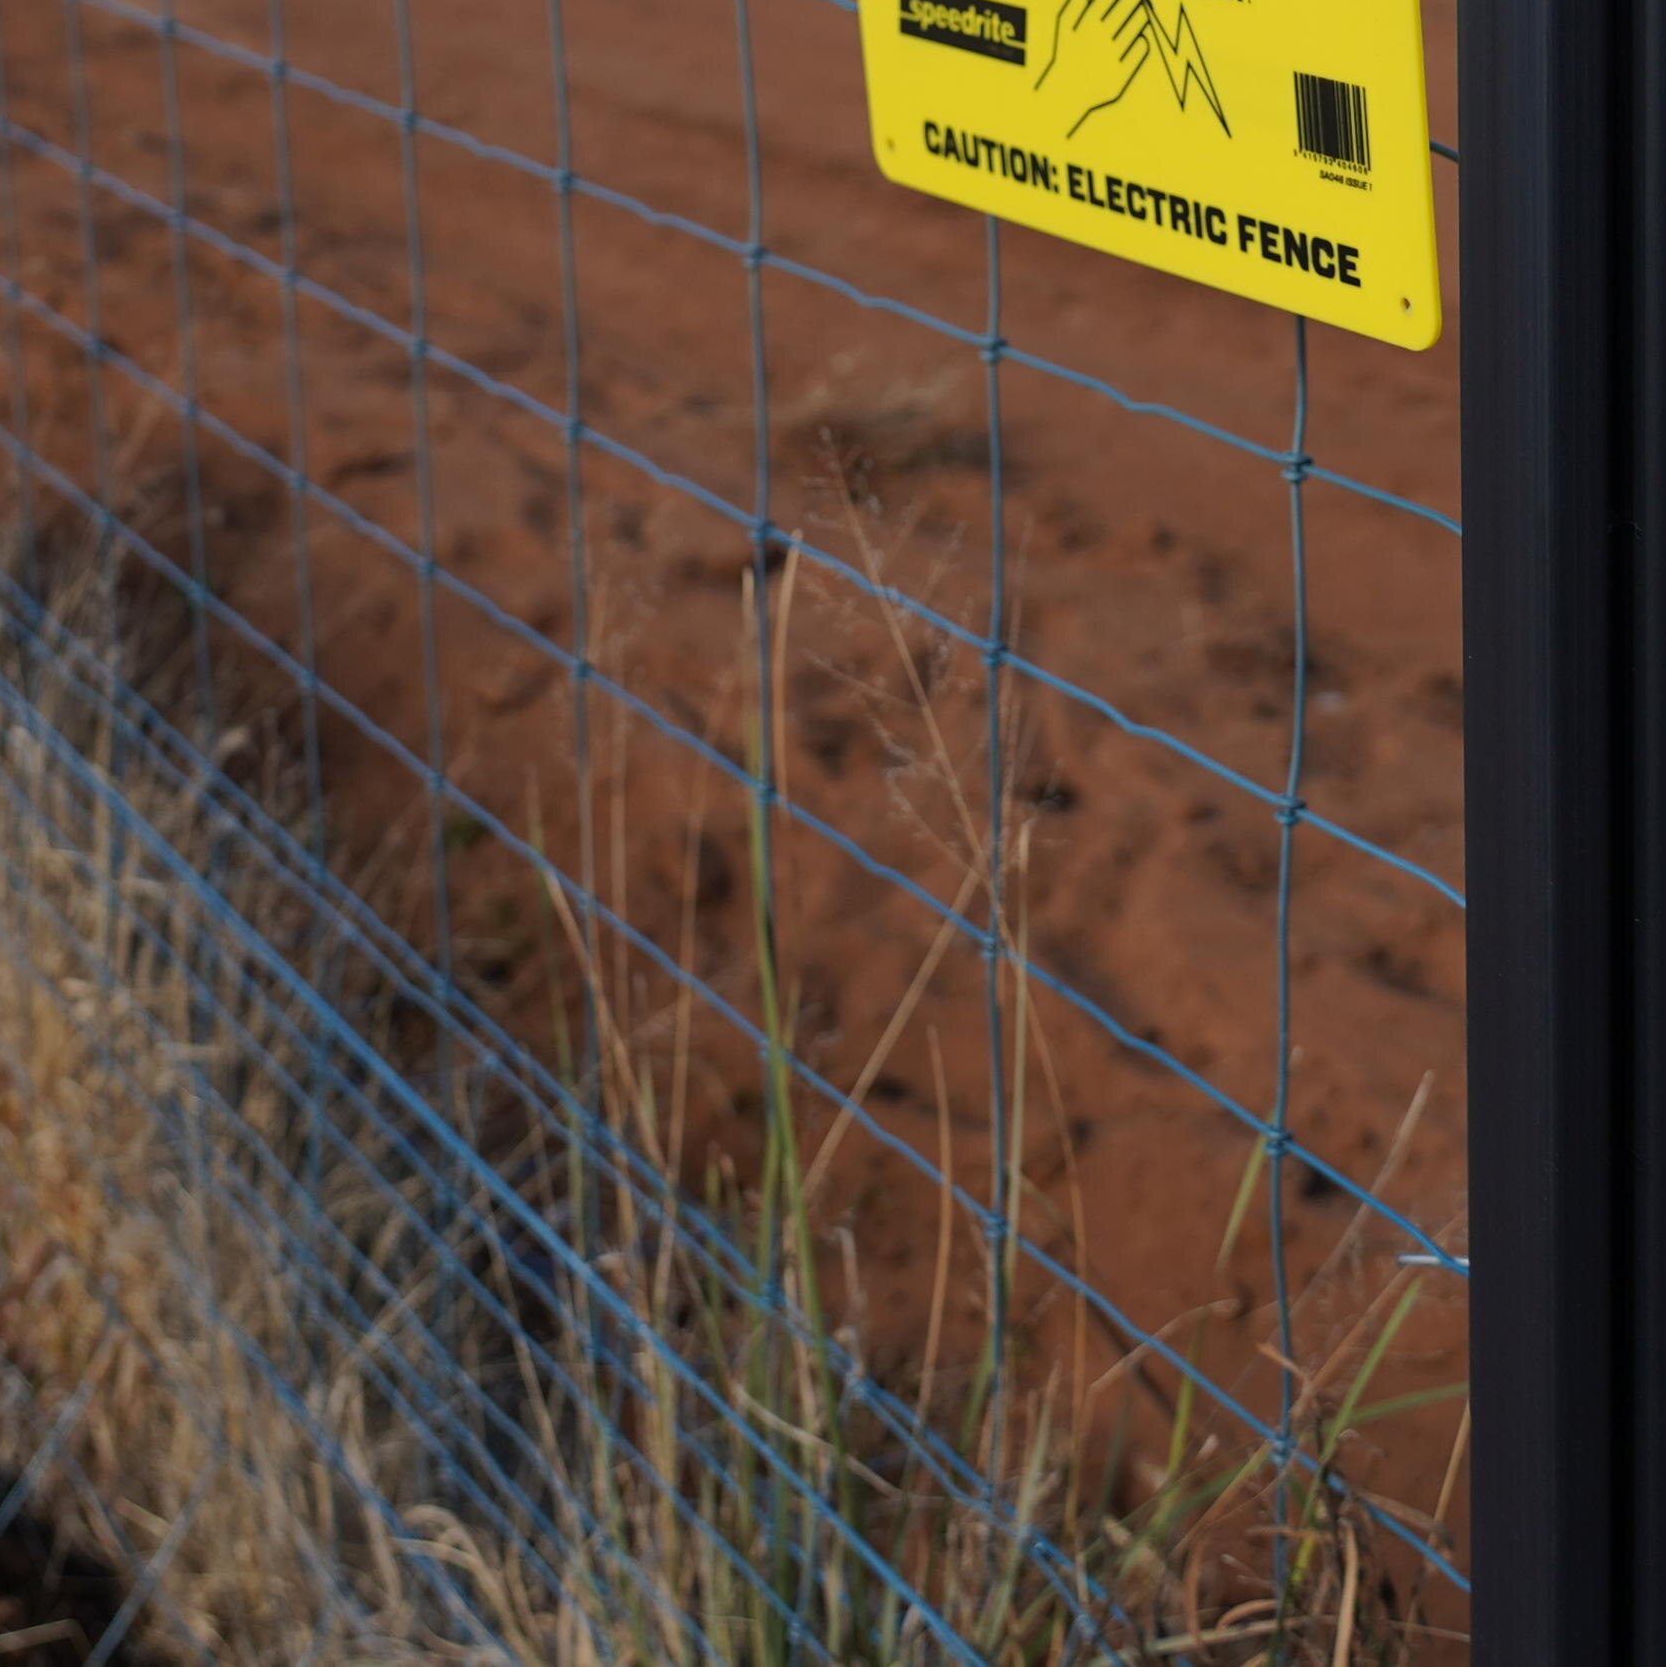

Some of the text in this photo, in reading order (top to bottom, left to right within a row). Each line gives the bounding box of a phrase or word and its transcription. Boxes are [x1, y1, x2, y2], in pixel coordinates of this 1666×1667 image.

[923, 120, 1363, 288] CAUTION: ELECTRIC FENCE
[1345, 177, 1368, 191] ISSUE
